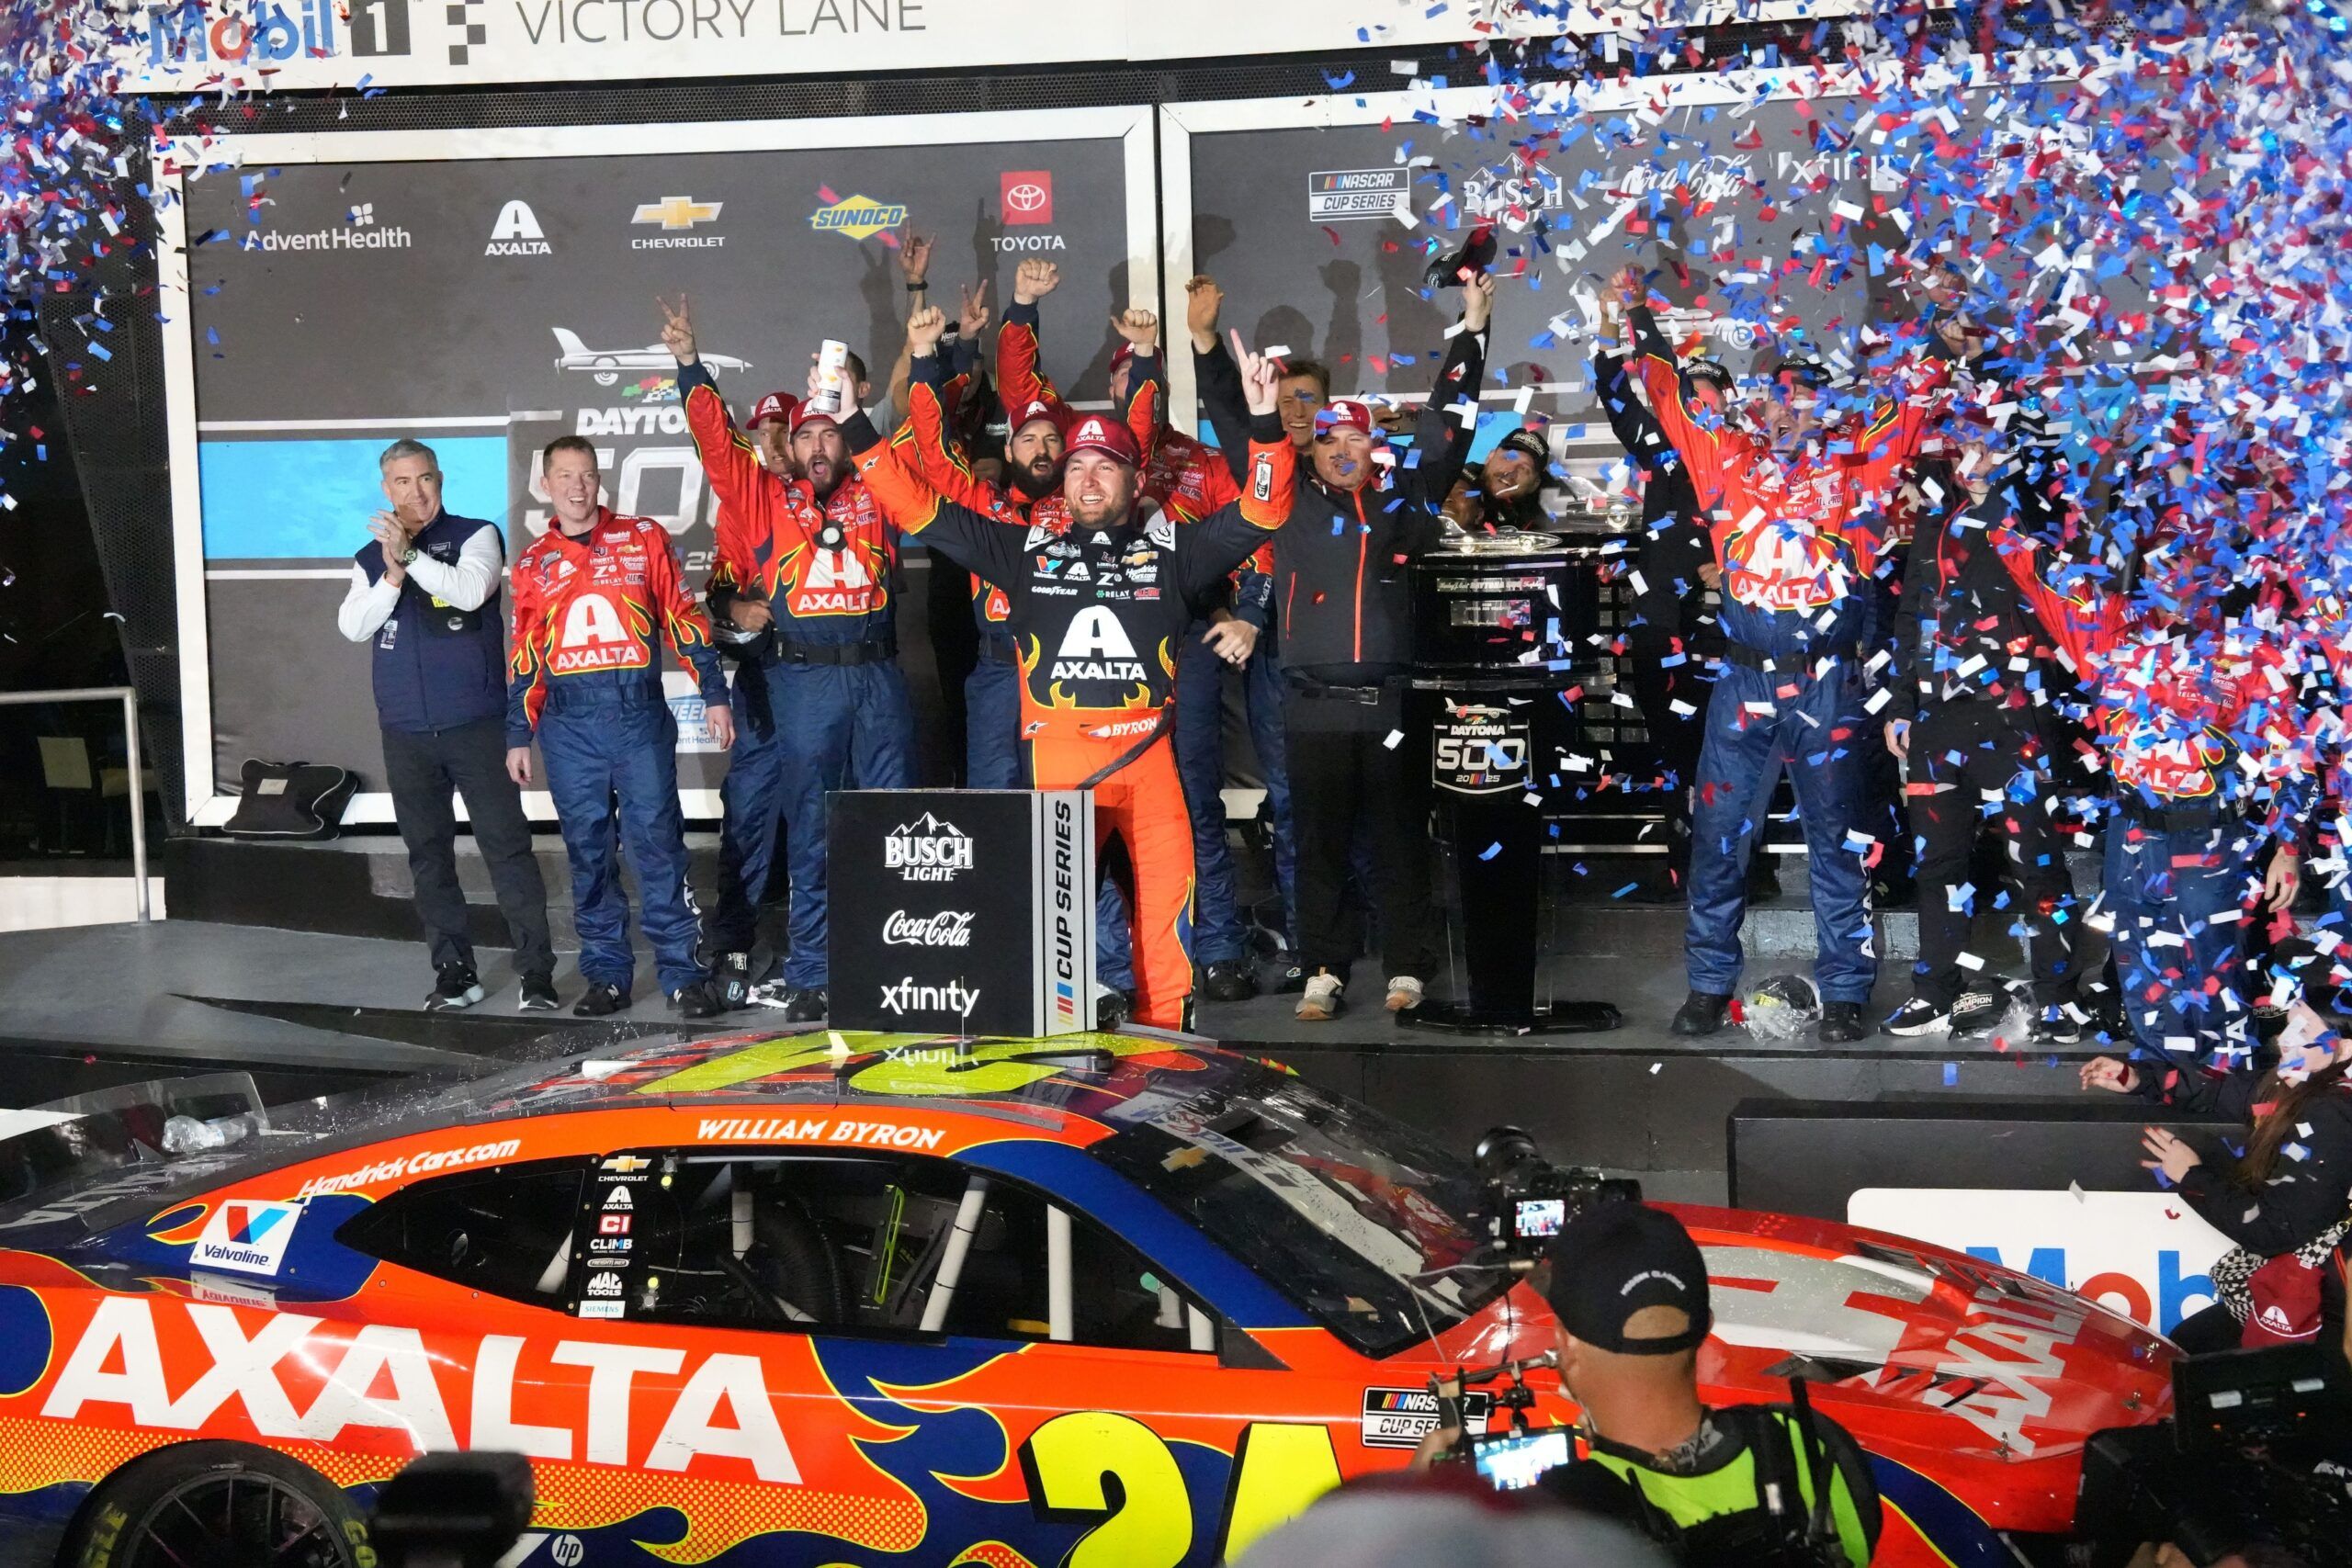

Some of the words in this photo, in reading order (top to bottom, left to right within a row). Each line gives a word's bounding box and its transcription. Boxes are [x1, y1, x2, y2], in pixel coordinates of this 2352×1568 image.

[147, 0, 335, 70] Mobil
[516, 0, 753, 46] VICTORY
[779, 0, 927, 37] LANE
[1340, 172, 1396, 189] NASCAR
[1323, 195, 1348, 211] CUP
[1351, 192, 1397, 211] SERIES
[812, 205, 908, 231] SUNOCO
[243, 226, 412, 253] AdventHealth
[484, 242, 551, 255] AXALTA
[631, 236, 726, 250] CHEVROLET
[990, 235, 1066, 253] TOYOTA
[576, 406, 695, 436] DAYTO
[1074, 434, 1106, 444] AXALTA
[525, 446, 721, 538] 50
[1032, 586, 1079, 596] GOODYEAR
[1105, 590, 1131, 598] RELAY
[1736, 577, 1828, 604] AXALTA
[797, 592, 872, 612] AXALT
[556, 646, 640, 670] AXALTA
[1050, 661, 1148, 681] AXALTA
[1112, 716, 1158, 736] BYRON
[1450, 725, 1506, 736] DAYTONA
[1436, 738, 1526, 770] 500
[1456, 774, 1470, 783] 20
[1485, 774, 1501, 783] 25
[884, 836, 974, 869] BUSCH
[1055, 799, 1072, 911] SERIES
[903, 867, 955, 882] LIGHT
[882, 909, 977, 947] Coca-Cola
[1056, 916, 1073, 981] CUP
[880, 976, 980, 1017] xfinity
[1952, 996, 1993, 1013] CHAMPION
[695, 1118, 827, 1143] WILLIAM
[829, 1121, 945, 1150] BYRON
[601, 1215, 631, 1233] CI
[204, 1242, 273, 1268] Valvoline
[587, 1271, 623, 1290] MAC
[587, 1289, 622, 1297] TOOLS
[1966, 1247, 2223, 1341] Mob
[585, 1305, 620, 1314] SIEMENS
[40, 1295, 803, 1485] AXALTA
[1380, 1417, 1412, 1435] CUP
[556, 1534, 581, 1567] hp
